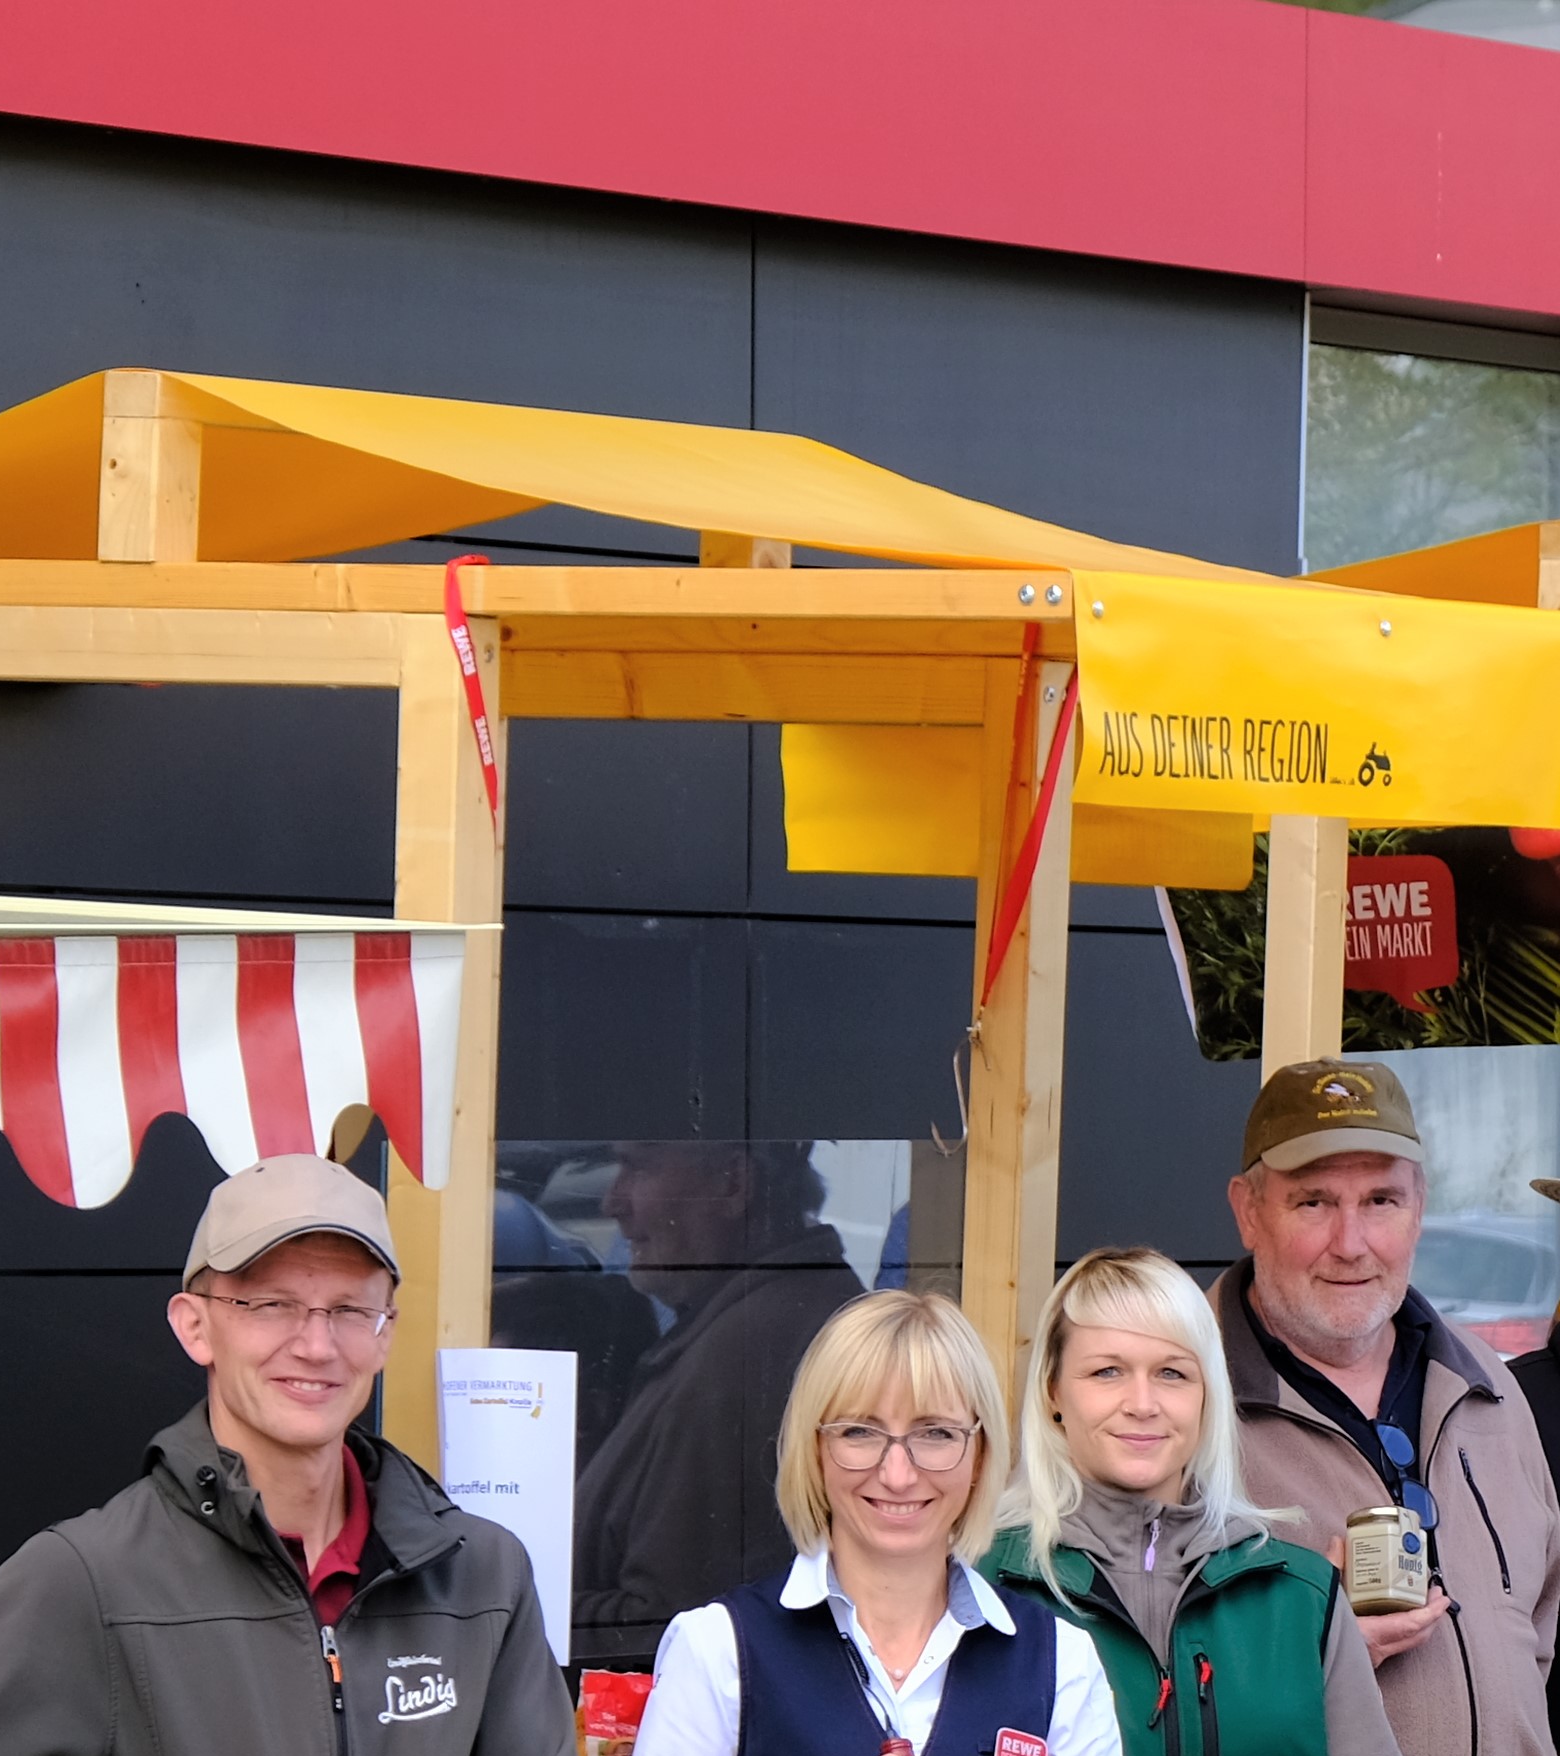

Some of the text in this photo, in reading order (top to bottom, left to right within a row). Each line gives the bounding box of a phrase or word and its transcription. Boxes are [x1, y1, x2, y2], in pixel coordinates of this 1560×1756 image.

[451, 624, 477, 676] REWE
[475, 715, 494, 766] REWE
[1099, 711, 1329, 784] AUS DEINER REGION
[1345, 921, 1433, 961] EIN MARKT
[495, 1482, 520, 1494] mit
[378, 1673, 458, 1724] Lindig
